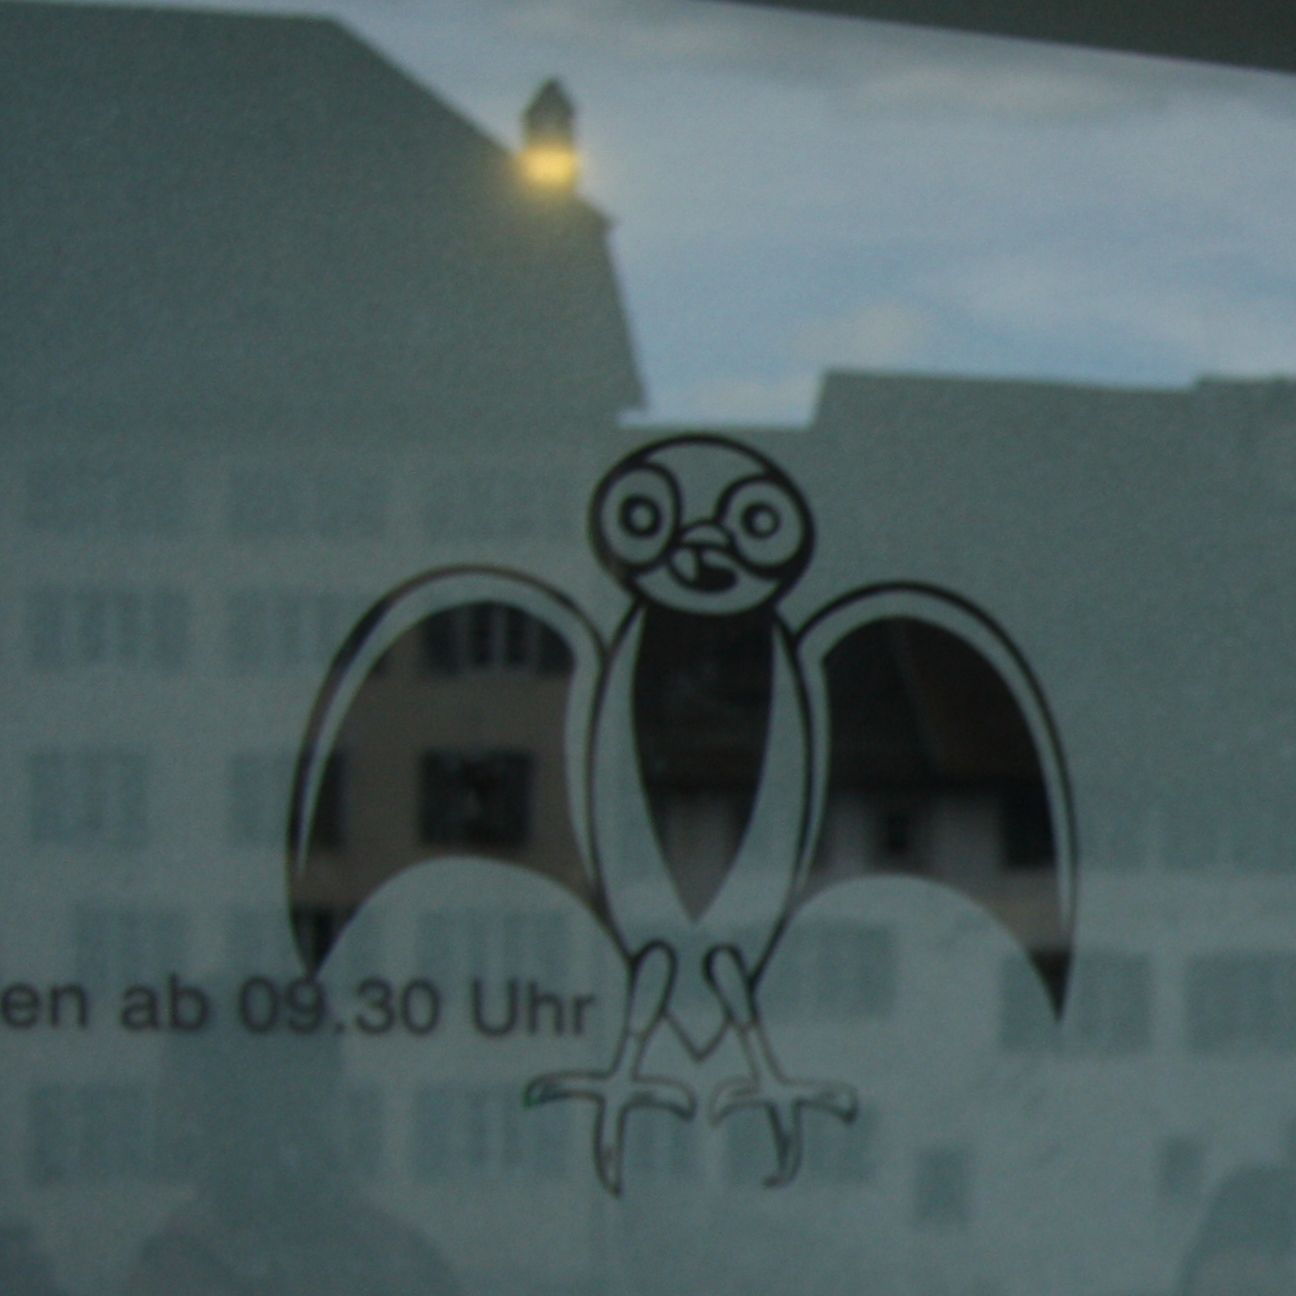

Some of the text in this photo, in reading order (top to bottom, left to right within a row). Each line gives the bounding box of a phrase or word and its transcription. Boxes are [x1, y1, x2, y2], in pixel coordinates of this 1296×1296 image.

[0, 974, 595, 1037] en ab 09.30 Uhr
